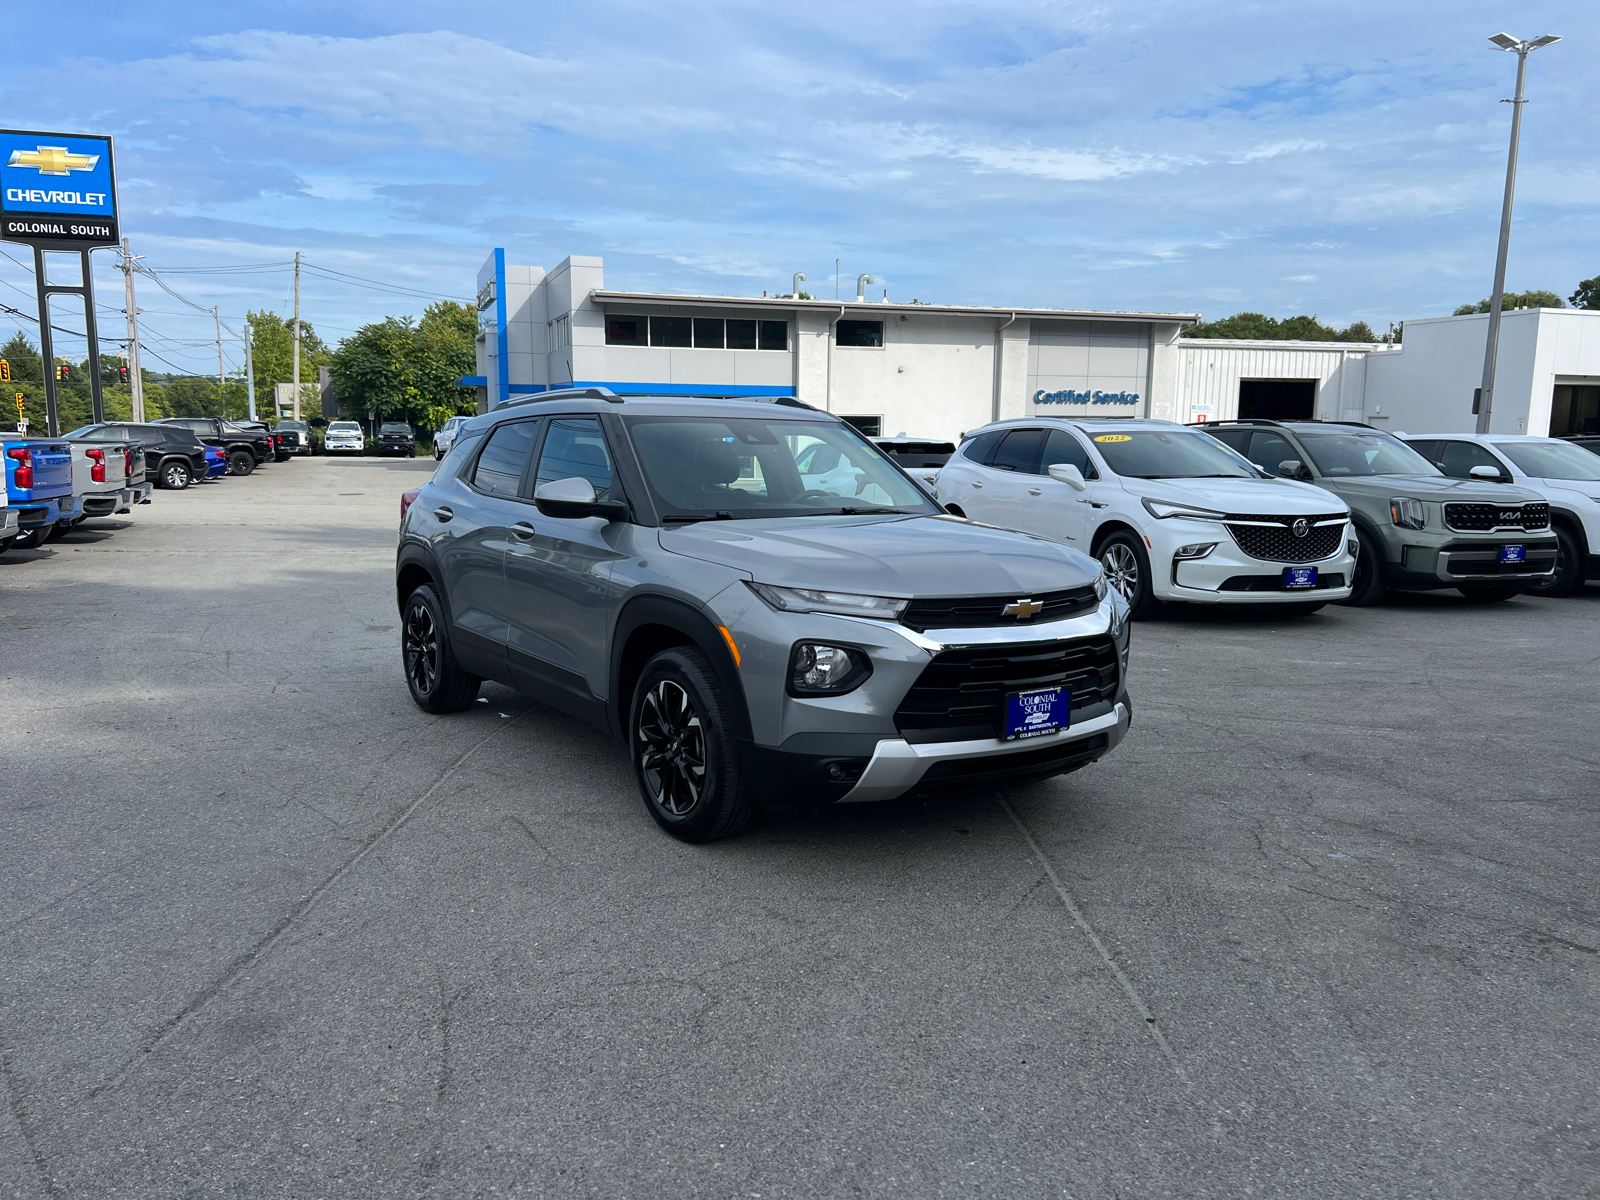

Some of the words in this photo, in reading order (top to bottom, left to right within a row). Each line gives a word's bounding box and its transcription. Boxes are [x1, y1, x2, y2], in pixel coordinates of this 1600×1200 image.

[7, 188, 106, 206] CHEVROLET
[8, 222, 67, 234] COLONIAL
[70, 225, 110, 236] SOUTH
[1035, 389, 1092, 403] Certified
[1095, 389, 1140, 403] Service
[1019, 694, 1057, 706] COLONIAL
[1024, 702, 1051, 714] SOUTH
[1020, 730, 1041, 738] COLONIAL
